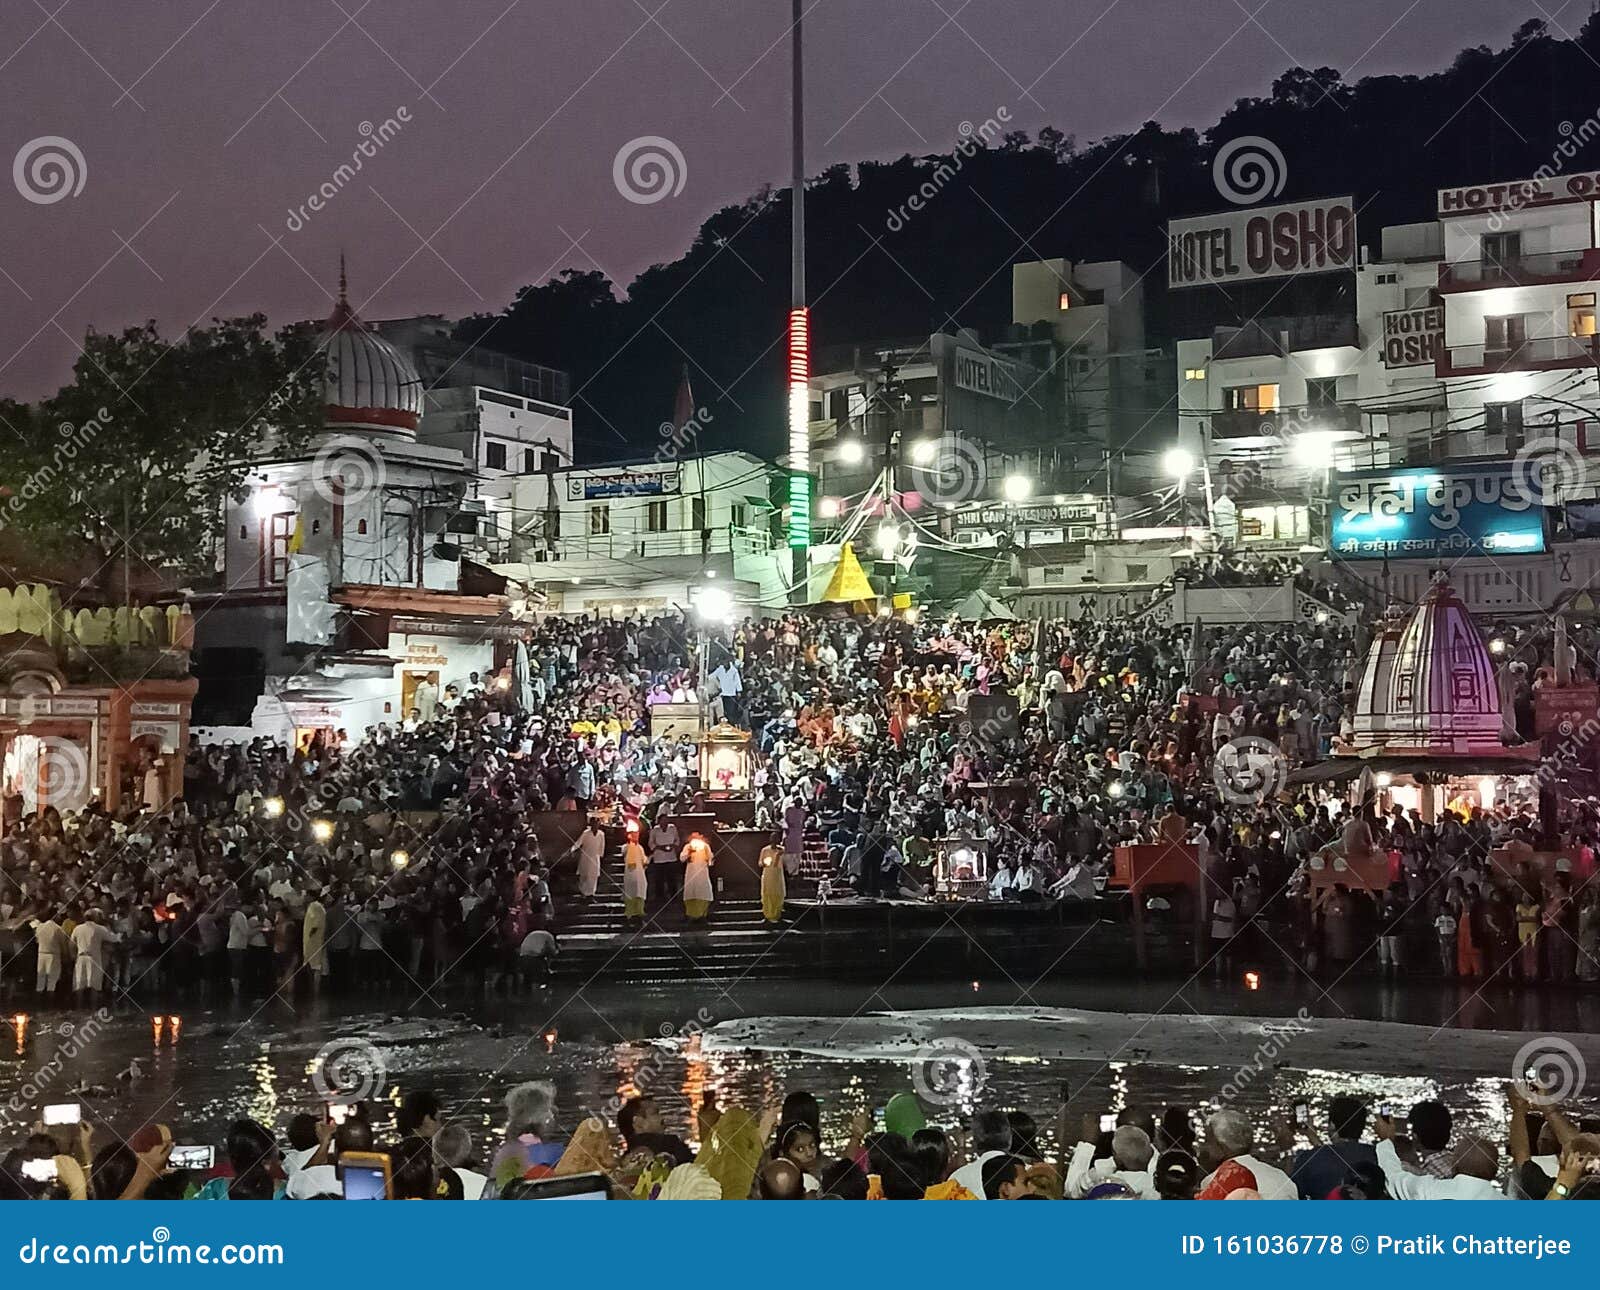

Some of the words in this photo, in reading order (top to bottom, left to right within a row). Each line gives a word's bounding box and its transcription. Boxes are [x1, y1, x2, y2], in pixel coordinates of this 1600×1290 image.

[1443, 179, 1554, 210] HOTEL
[1171, 227, 1240, 283] HOTEL
[1246, 205, 1354, 275] OSHO
[957, 355, 992, 392] HOTEL
[957, 511, 980, 525] SHRI
